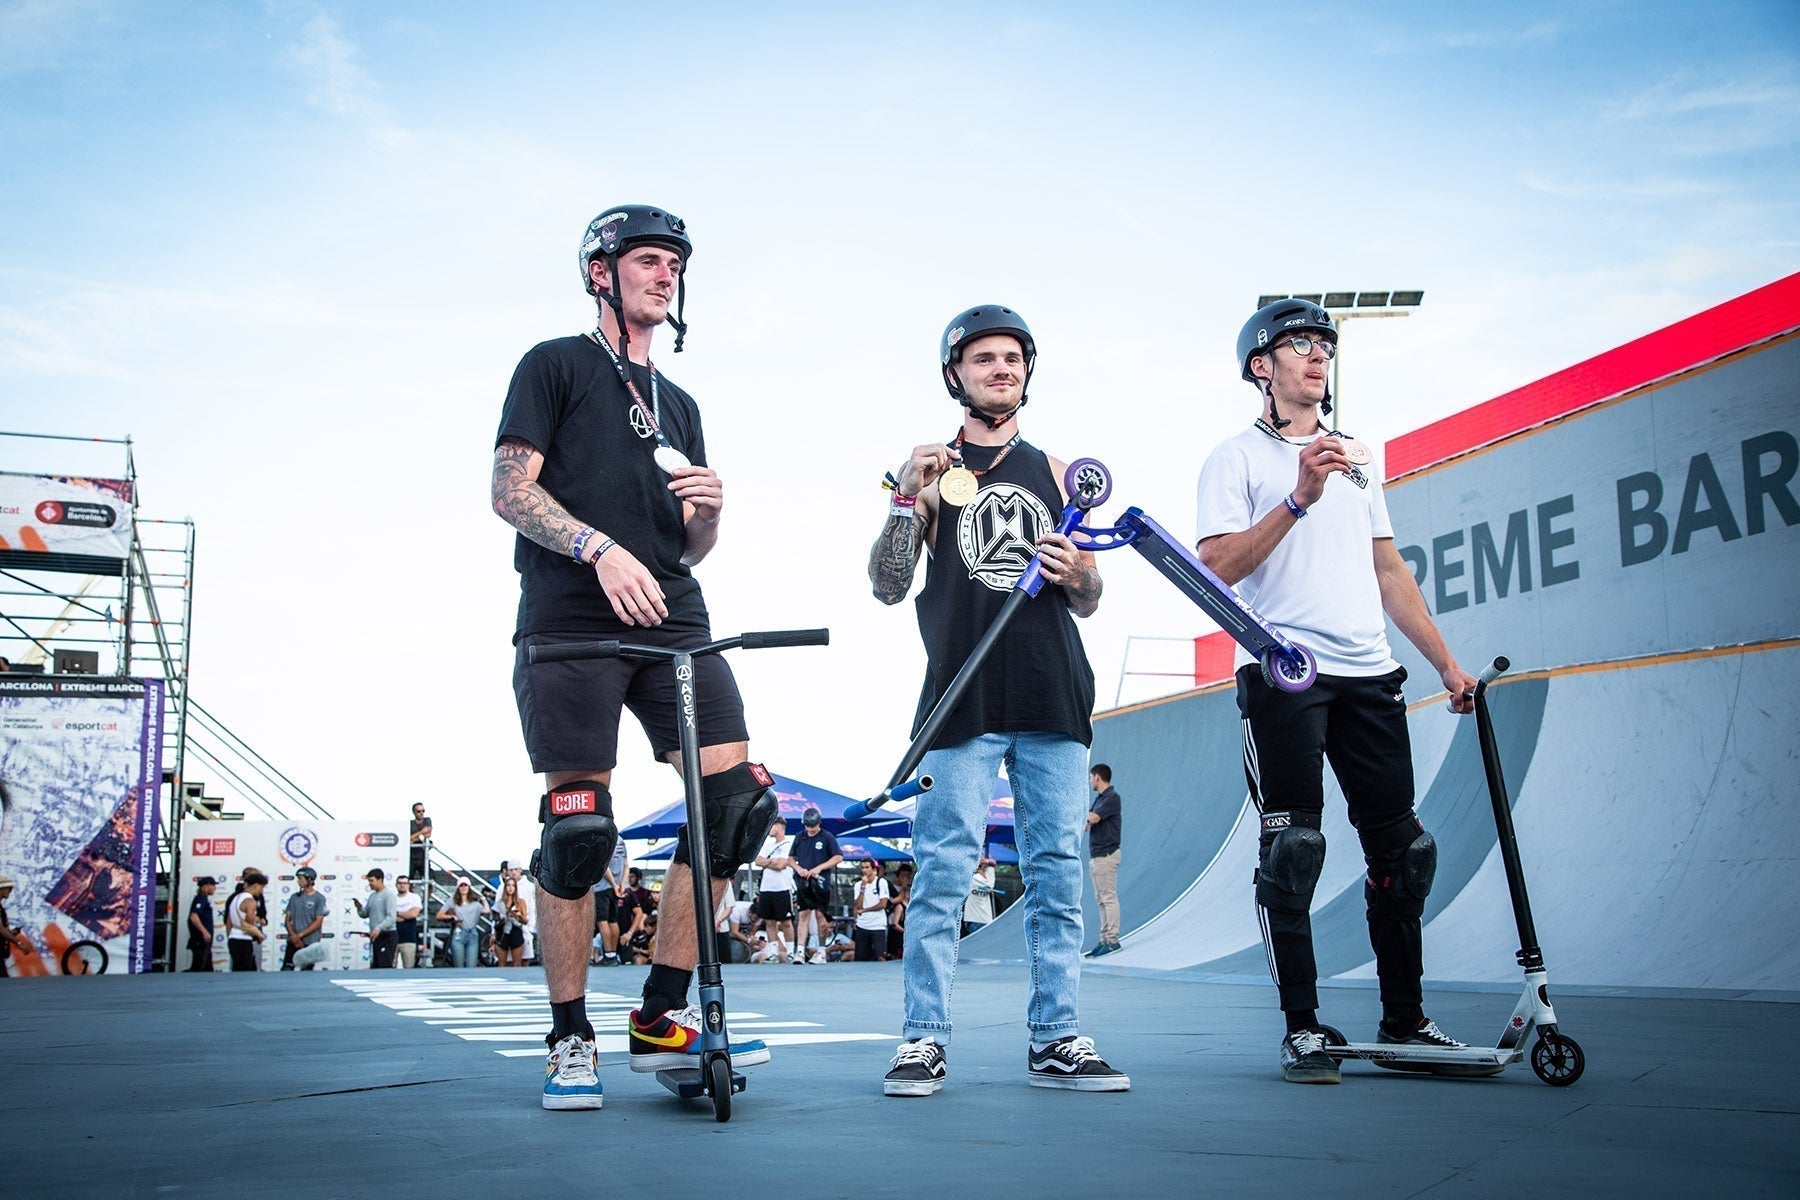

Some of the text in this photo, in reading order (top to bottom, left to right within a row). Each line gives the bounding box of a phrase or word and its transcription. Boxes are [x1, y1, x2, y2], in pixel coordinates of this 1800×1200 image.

[67, 511, 107, 522] Barcelona
[1616, 430, 1800, 568] BAR
[60, 683, 106, 692] EXTREME
[681, 682, 696, 729] APEX
[65, 720, 118, 731] esportcat
[145, 685, 159, 783] EXTREME BARCELONA
[555, 793, 590, 812] CORE
[139, 788, 154, 889] EXTREME BARCELONA
[136, 894, 147, 938] EXTREME
